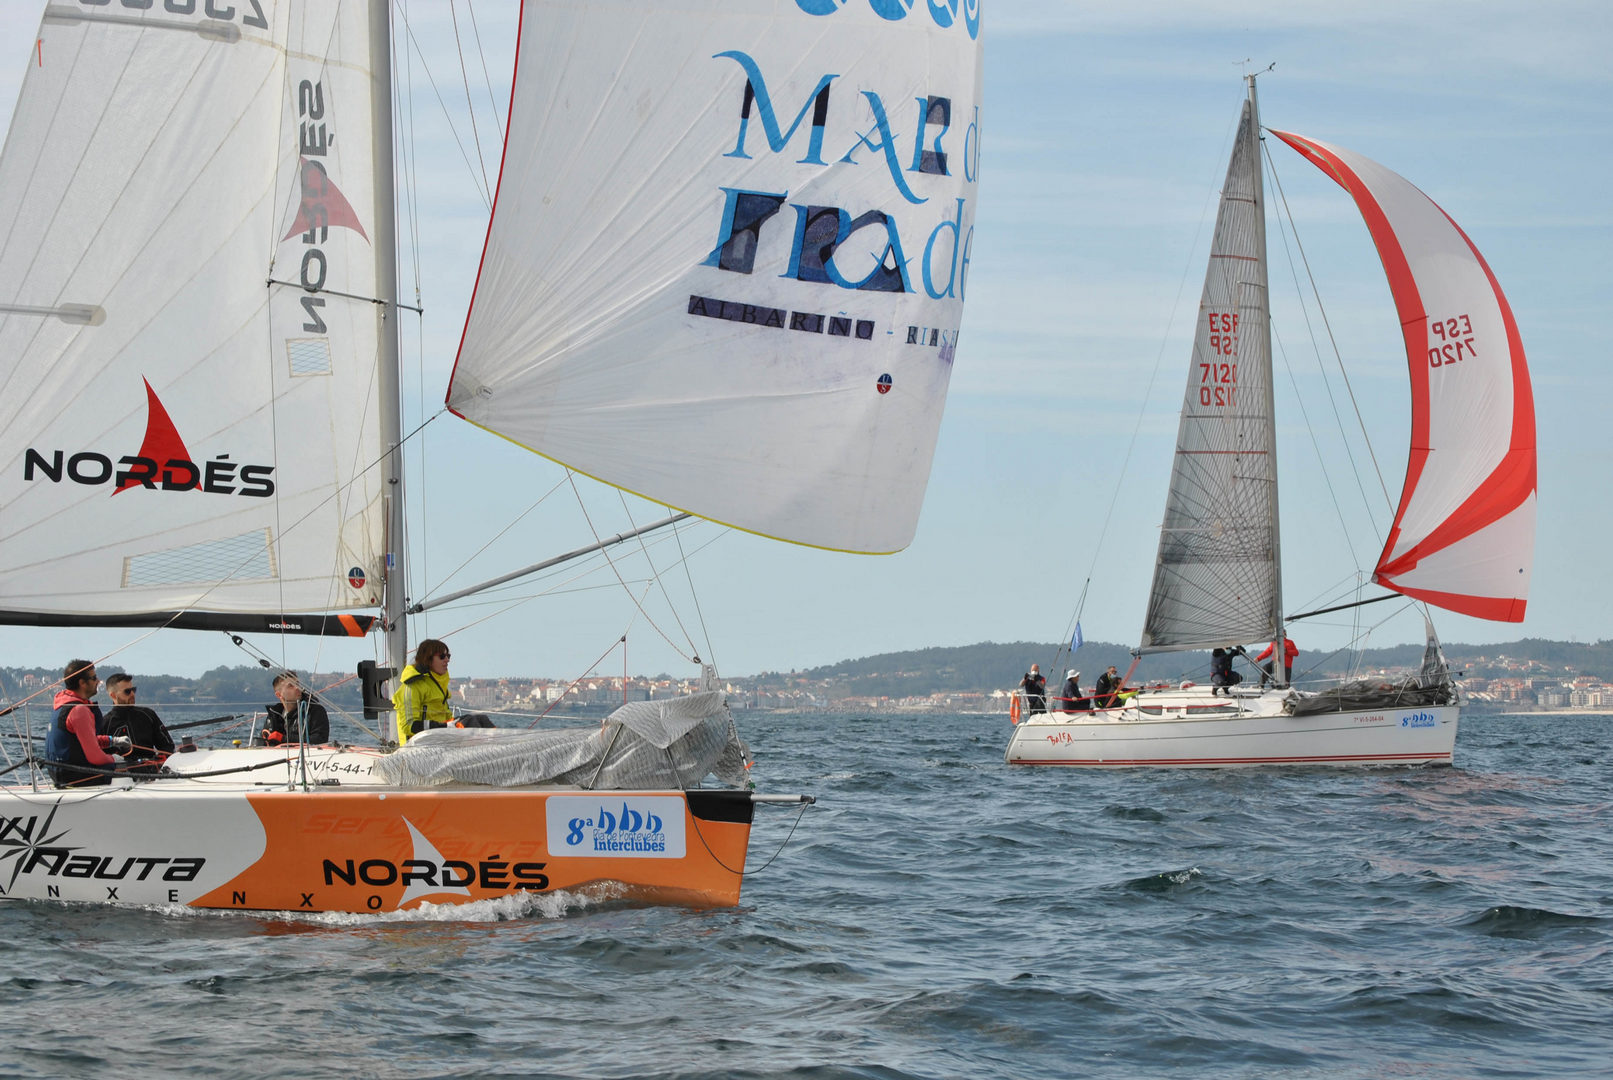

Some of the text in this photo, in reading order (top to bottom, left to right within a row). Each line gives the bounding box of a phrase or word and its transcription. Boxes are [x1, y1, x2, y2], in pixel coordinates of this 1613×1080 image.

[712, 50, 952, 204] MAR
[688, 295, 875, 341] ALBARIÑO
[24, 448, 275, 497] NORDÉS
[566, 818, 593, 845] 8ª
[594, 838, 665, 851] Interclubes
[322, 854, 549, 890] NORDÉS
